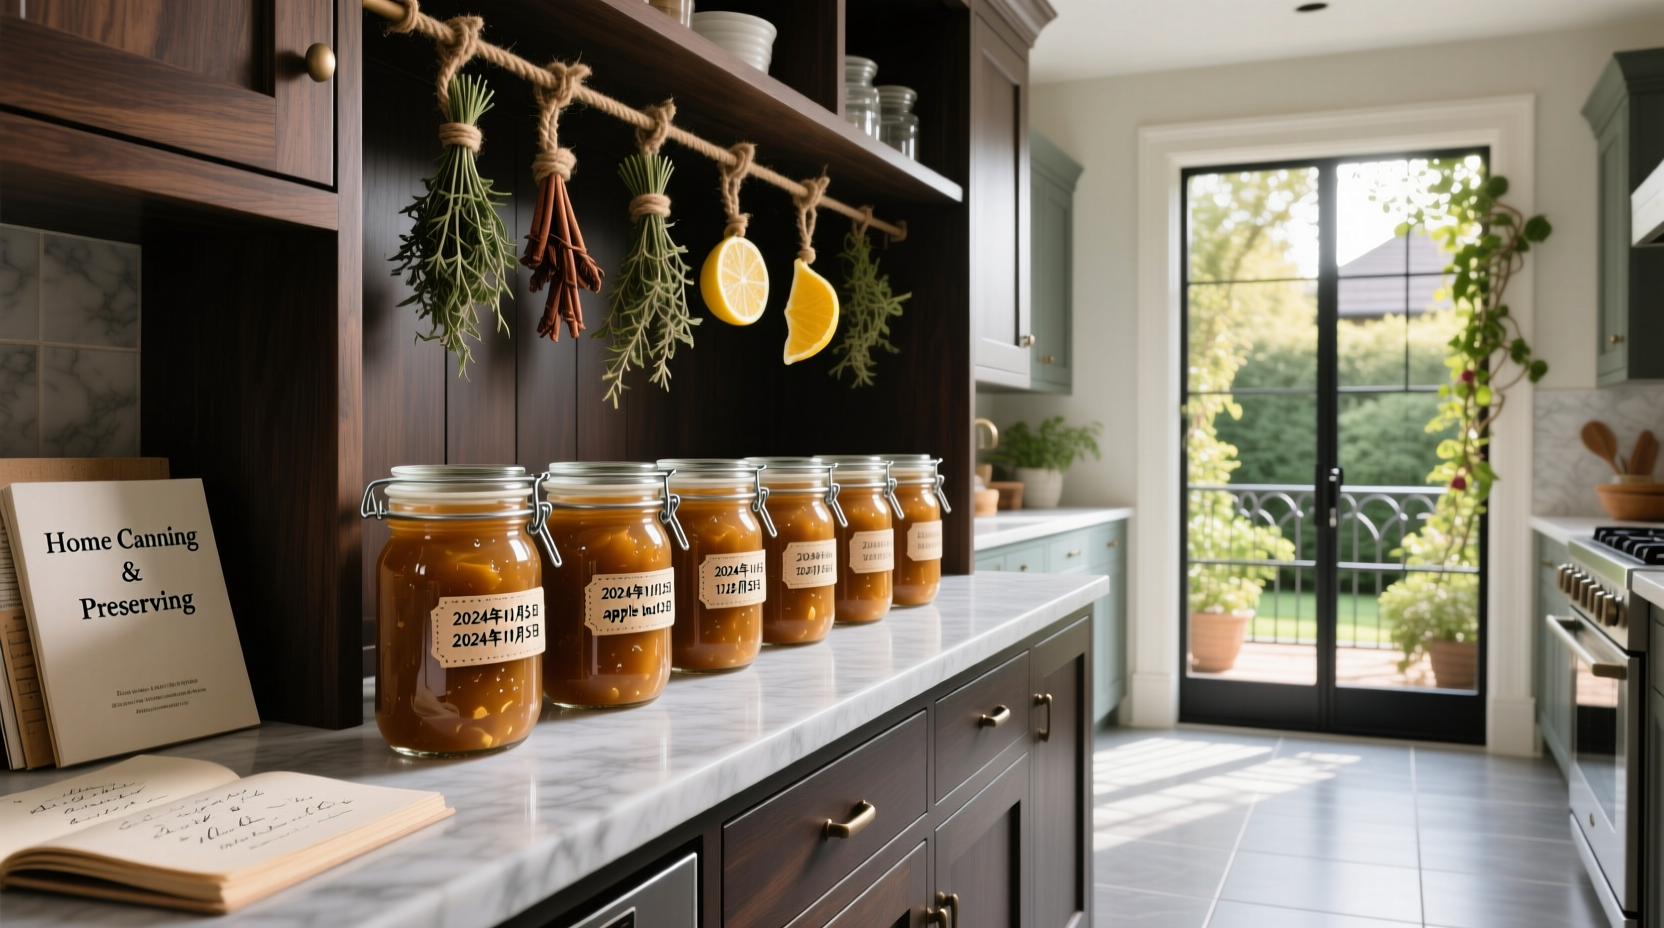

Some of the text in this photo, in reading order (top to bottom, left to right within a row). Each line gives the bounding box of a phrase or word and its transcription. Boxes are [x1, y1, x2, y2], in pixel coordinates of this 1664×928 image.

[44, 526, 200, 554] Home Canning
[121, 560, 143, 583] &
[79, 590, 196, 620] Preserving
[452, 604, 539, 626] 2024年11月5日
[602, 605, 639, 623] apple
[452, 623, 539, 648] 2024年11月5日
